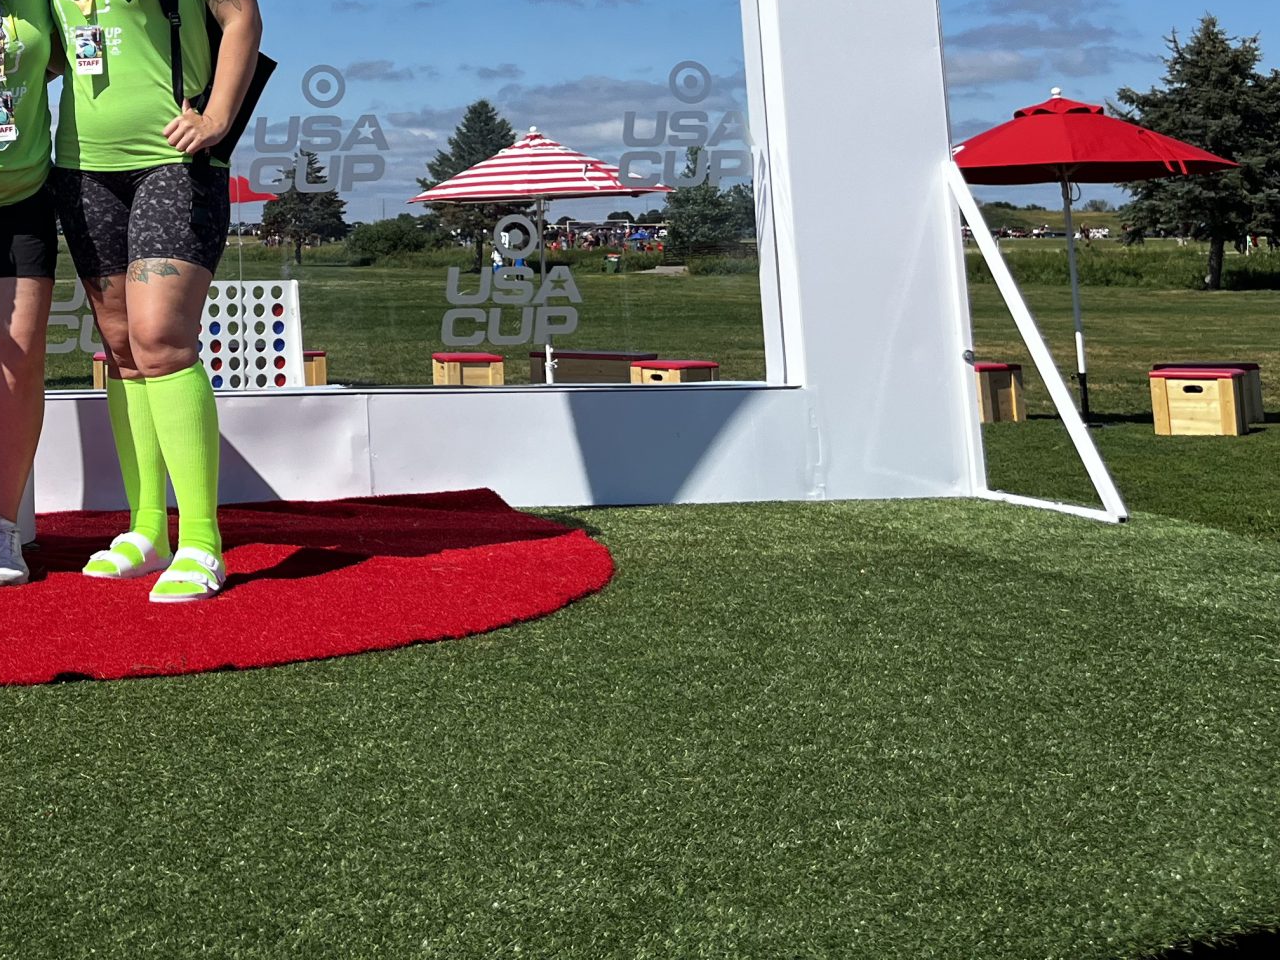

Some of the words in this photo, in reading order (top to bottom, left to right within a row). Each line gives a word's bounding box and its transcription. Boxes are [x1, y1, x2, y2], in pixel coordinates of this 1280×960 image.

[254, 115, 389, 152] USA
[623, 111, 755, 147] USA
[249, 155, 385, 193] CUP
[619, 150, 754, 188] CUP
[447, 266, 582, 304] USA
[441, 307, 578, 346] CUP
